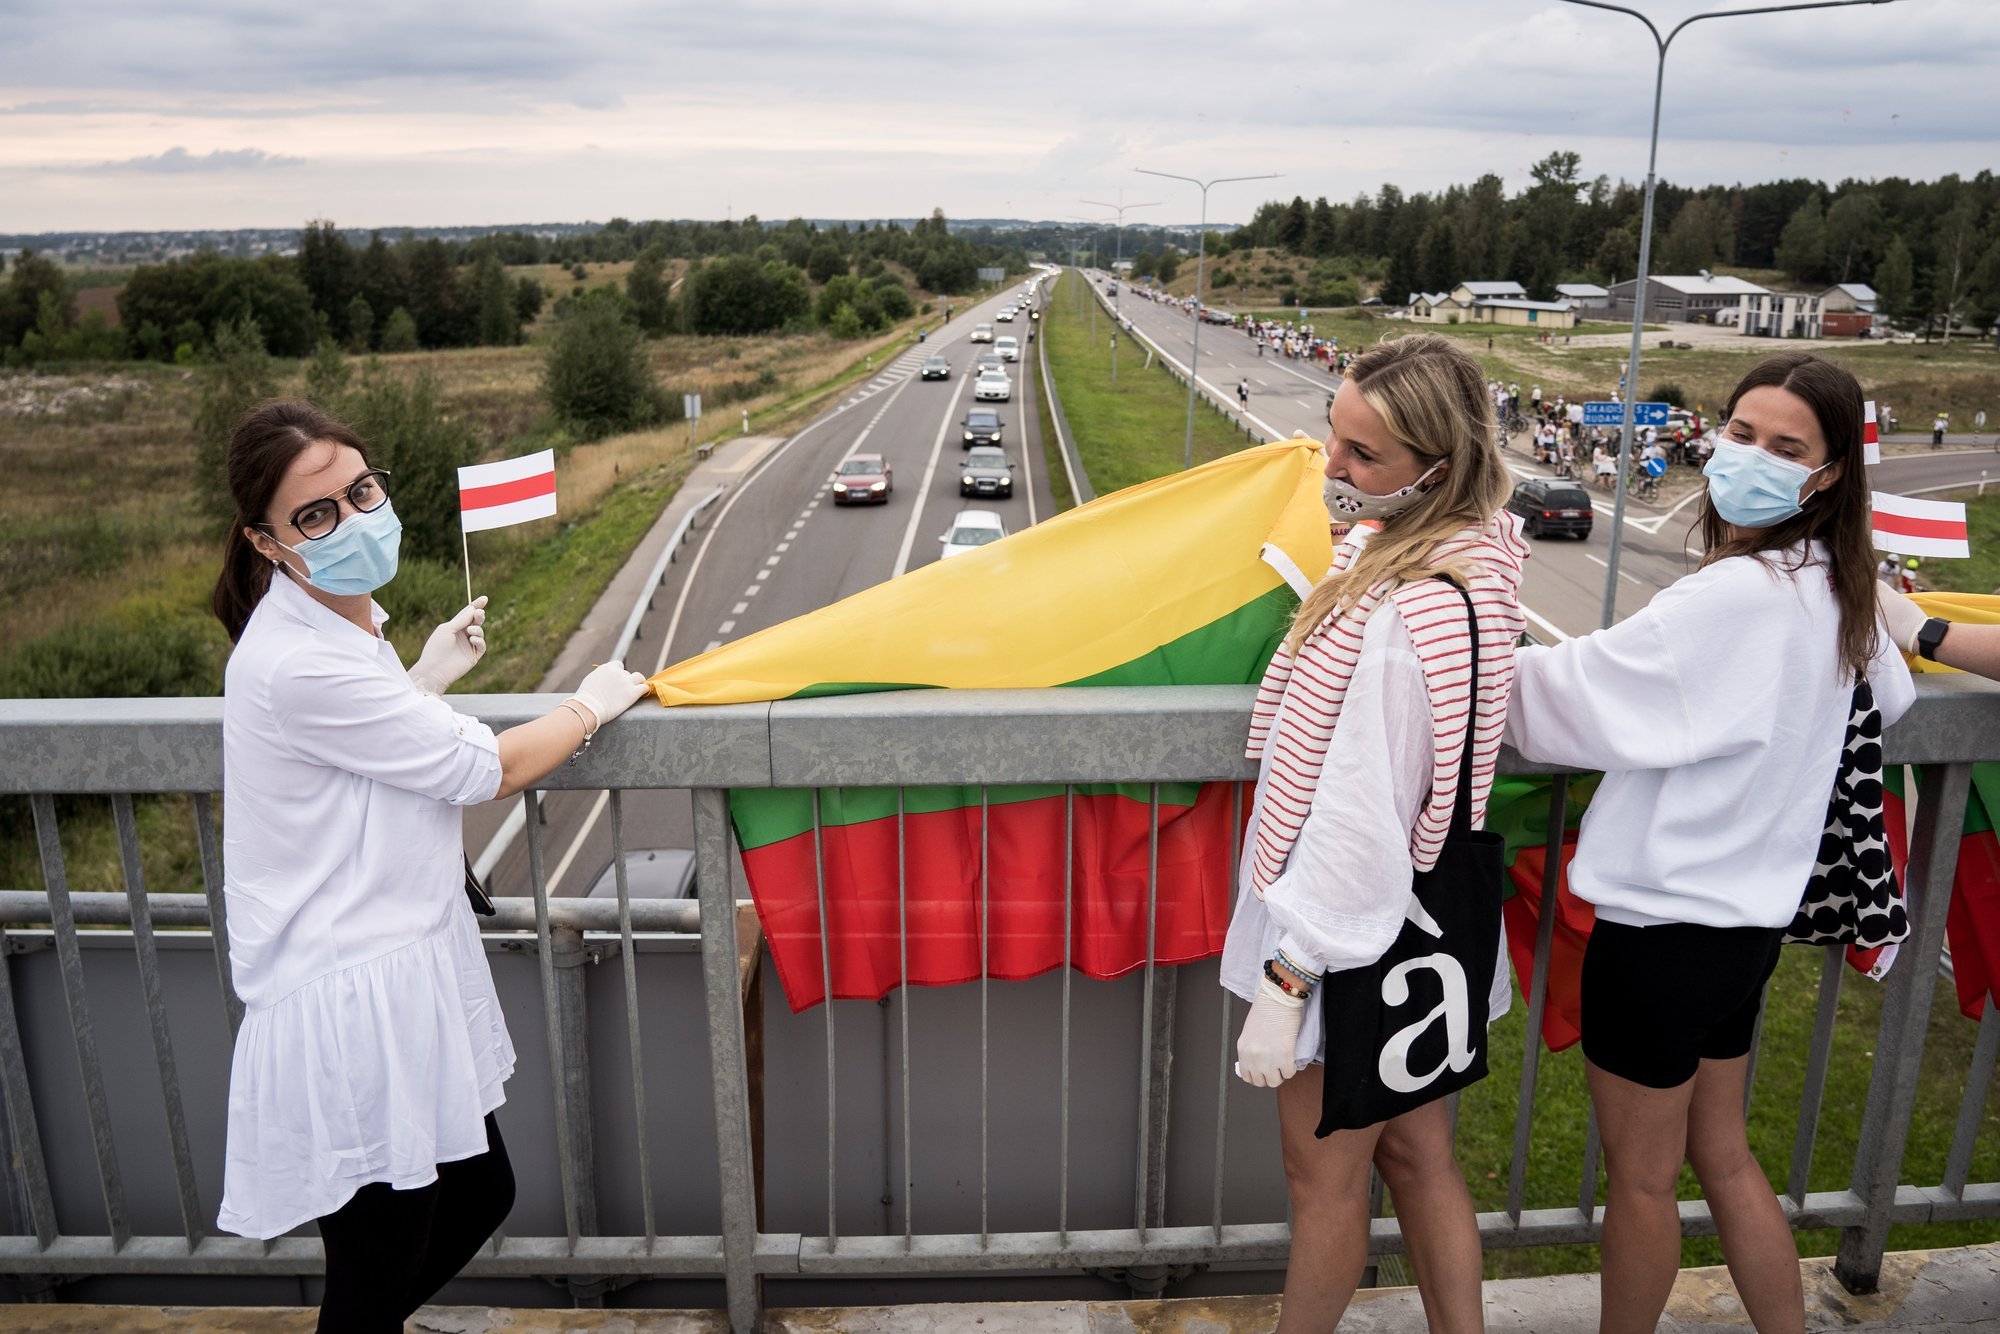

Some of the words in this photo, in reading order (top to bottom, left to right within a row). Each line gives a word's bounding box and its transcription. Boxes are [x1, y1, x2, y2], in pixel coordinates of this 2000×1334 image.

[1586, 403, 1643, 414] SKAIDIŠS
[1644, 405, 1651, 414] 2
[1584, 414, 1637, 423] RUDAMIA
[1643, 414, 1650, 424] 5
